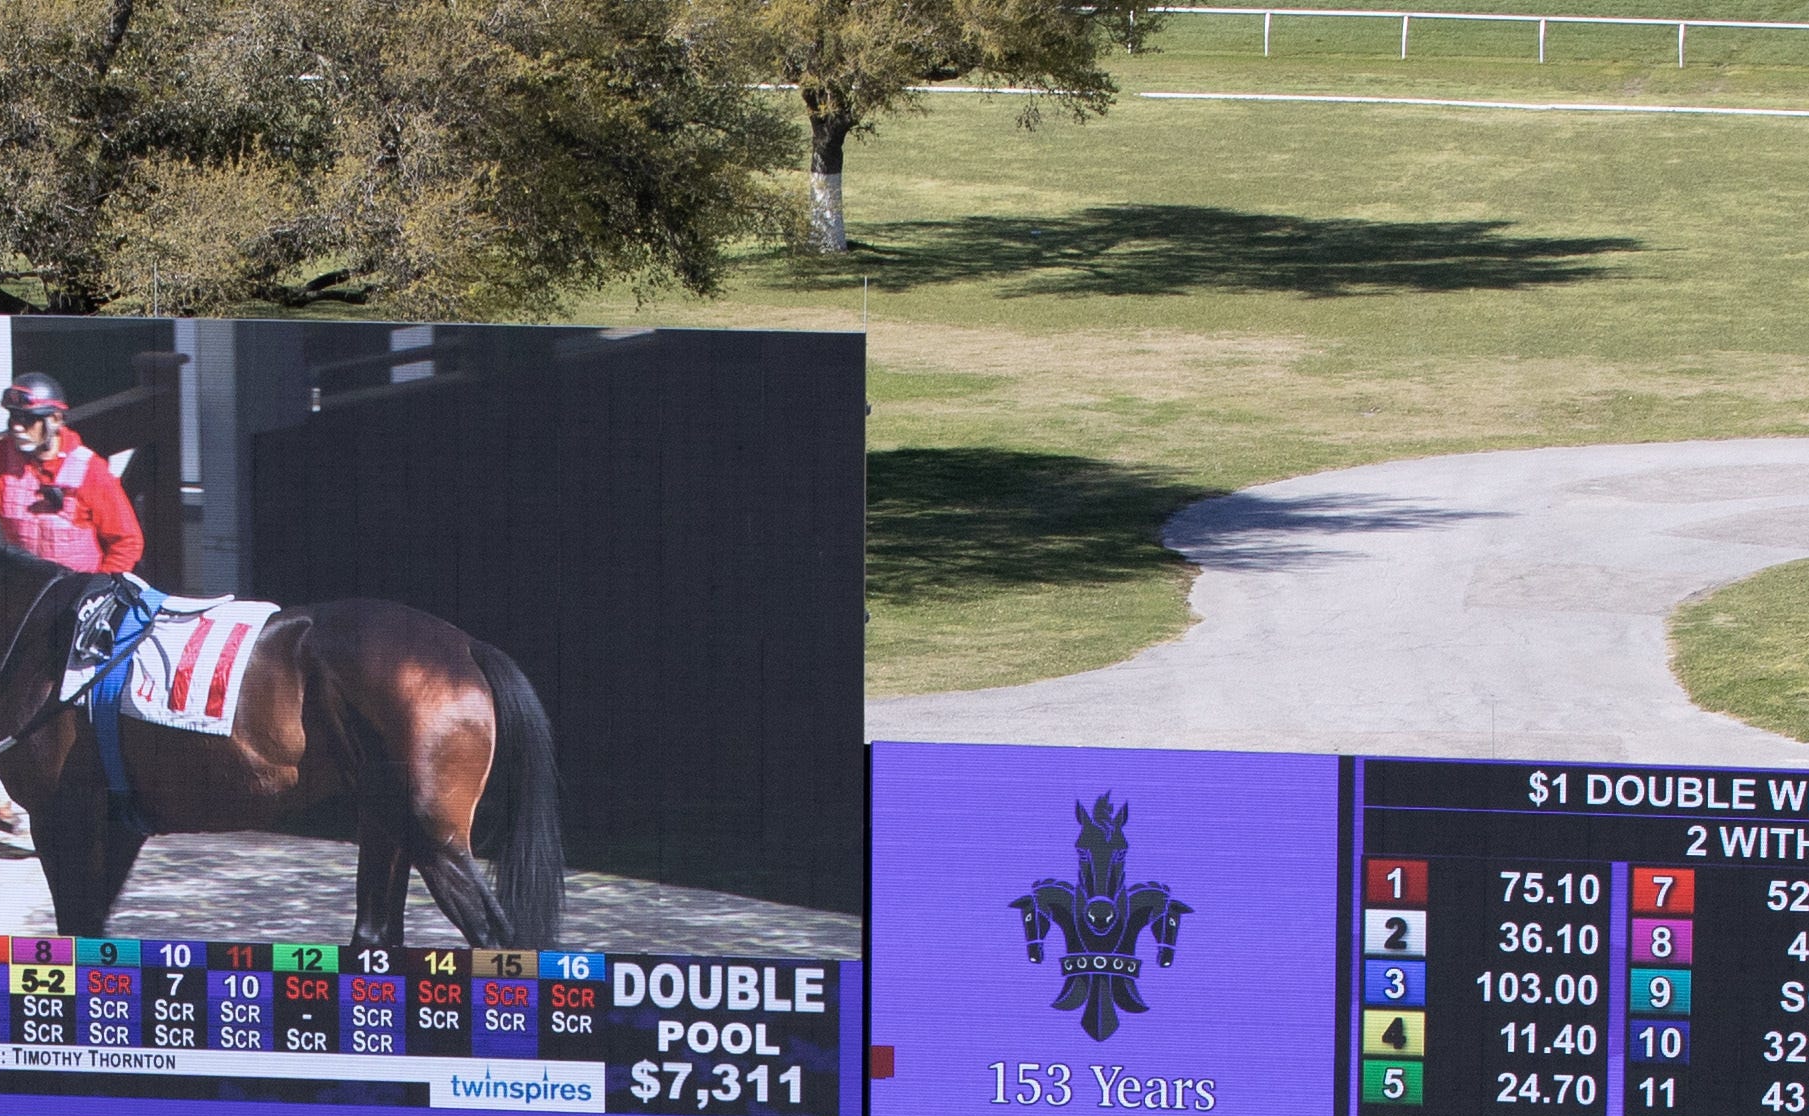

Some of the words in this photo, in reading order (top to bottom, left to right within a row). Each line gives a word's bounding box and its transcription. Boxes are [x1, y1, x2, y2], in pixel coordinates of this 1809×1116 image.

[1528, 770, 1567, 807] $1
[1587, 774, 1756, 810] DOUBLE
[1686, 825, 1707, 857] 2
[1387, 867, 1402, 899] 1
[1500, 871, 1600, 905] 75.10
[1653, 876, 1673, 907] 7
[1384, 917, 1407, 951] 2
[1499, 921, 1599, 955] 36.10
[1651, 926, 1672, 958] 8
[159, 944, 191, 967] 10
[357, 949, 390, 974] 13
[424, 951, 457, 975] 14
[556, 955, 590, 979] 16
[21, 969, 67, 994] 5-2
[166, 973, 184, 996] 7
[223, 975, 259, 999] 10
[613, 962, 825, 1013] DOUBLE
[1385, 968, 1405, 999] 3
[1477, 971, 1598, 1006] 103.00
[1650, 977, 1671, 1008] 9
[658, 1020, 780, 1056] POOL
[1381, 1017, 1408, 1050] 4
[1500, 1022, 1597, 1055] 11.40
[1639, 1026, 1681, 1058] 10
[451, 1064, 593, 1105] twinspires
[630, 1059, 801, 1109] $7,311
[988, 1060, 1076, 1108] 153
[1087, 1062, 1218, 1114] Years
[1383, 1068, 1404, 1099] 5
[1496, 1072, 1596, 1105] 24.70
[1639, 1077, 1674, 1108] 11
